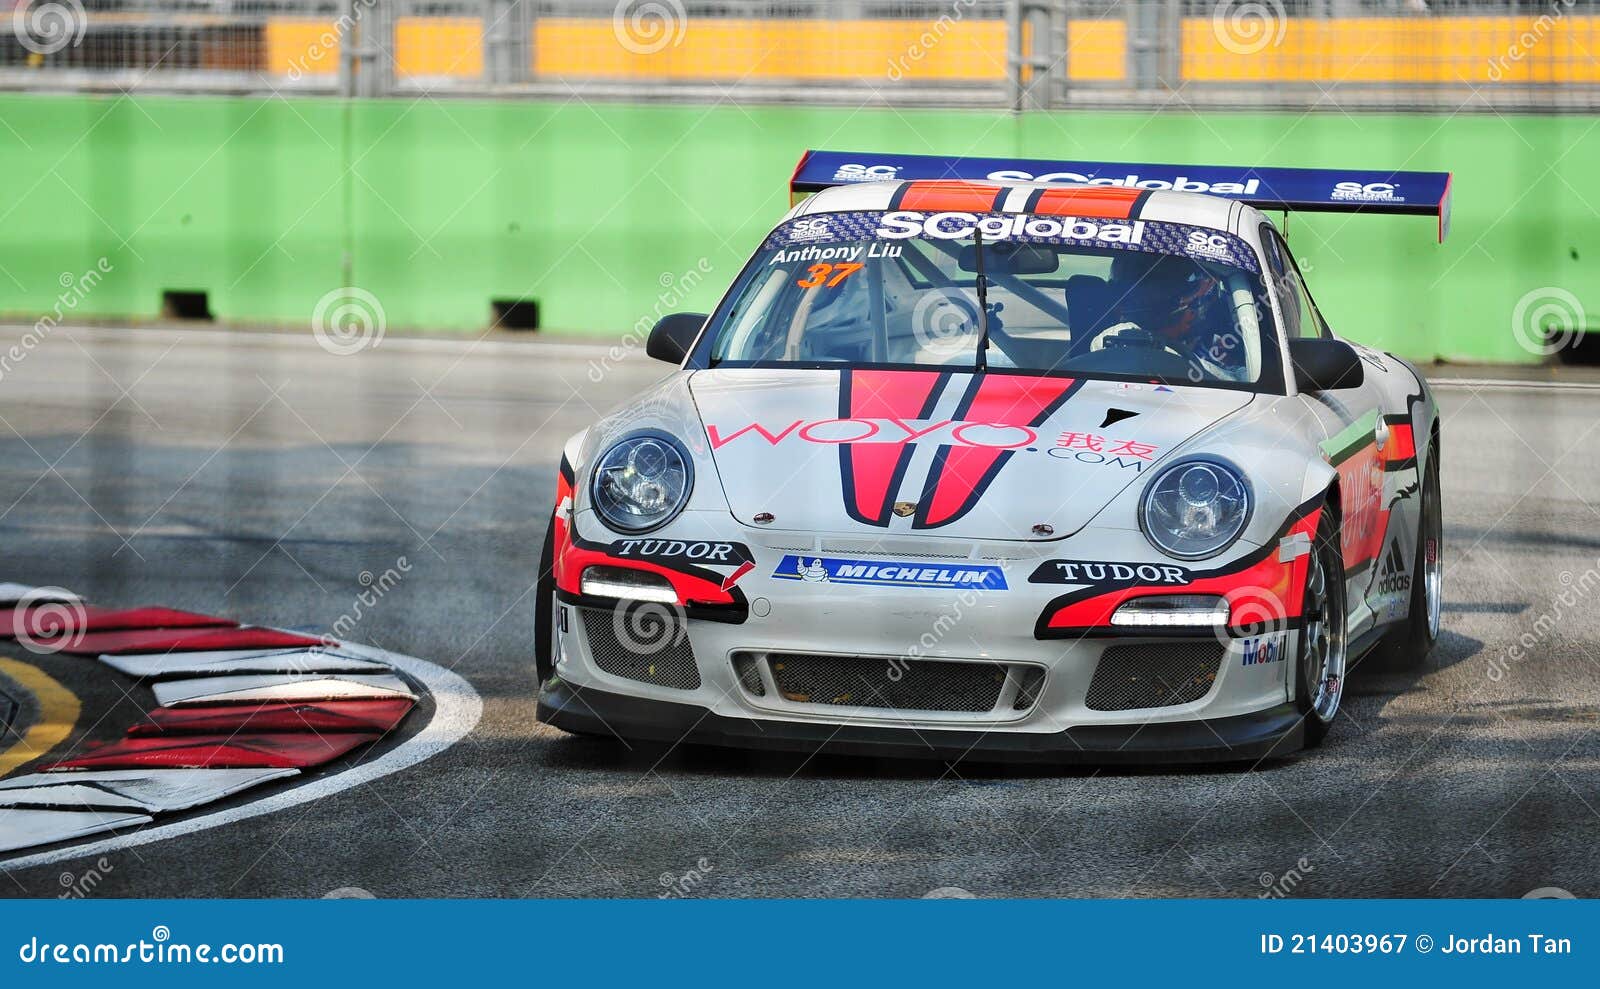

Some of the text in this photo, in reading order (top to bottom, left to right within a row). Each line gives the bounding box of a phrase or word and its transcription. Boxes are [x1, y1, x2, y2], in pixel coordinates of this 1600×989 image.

[1333, 182, 1395, 193] SC
[794, 217, 829, 230] SC
[876, 211, 1145, 245] SCglobal
[1188, 231, 1228, 249] SC
[768, 242, 903, 265] Anthony Liu
[797, 262, 865, 288] 37
[1056, 431, 1160, 461] 我友
[618, 540, 733, 561] TUDOR
[835, 564, 989, 583] MICHELIN
[1056, 563, 1189, 584] TUDOR
[1379, 573, 1410, 596] adidas
